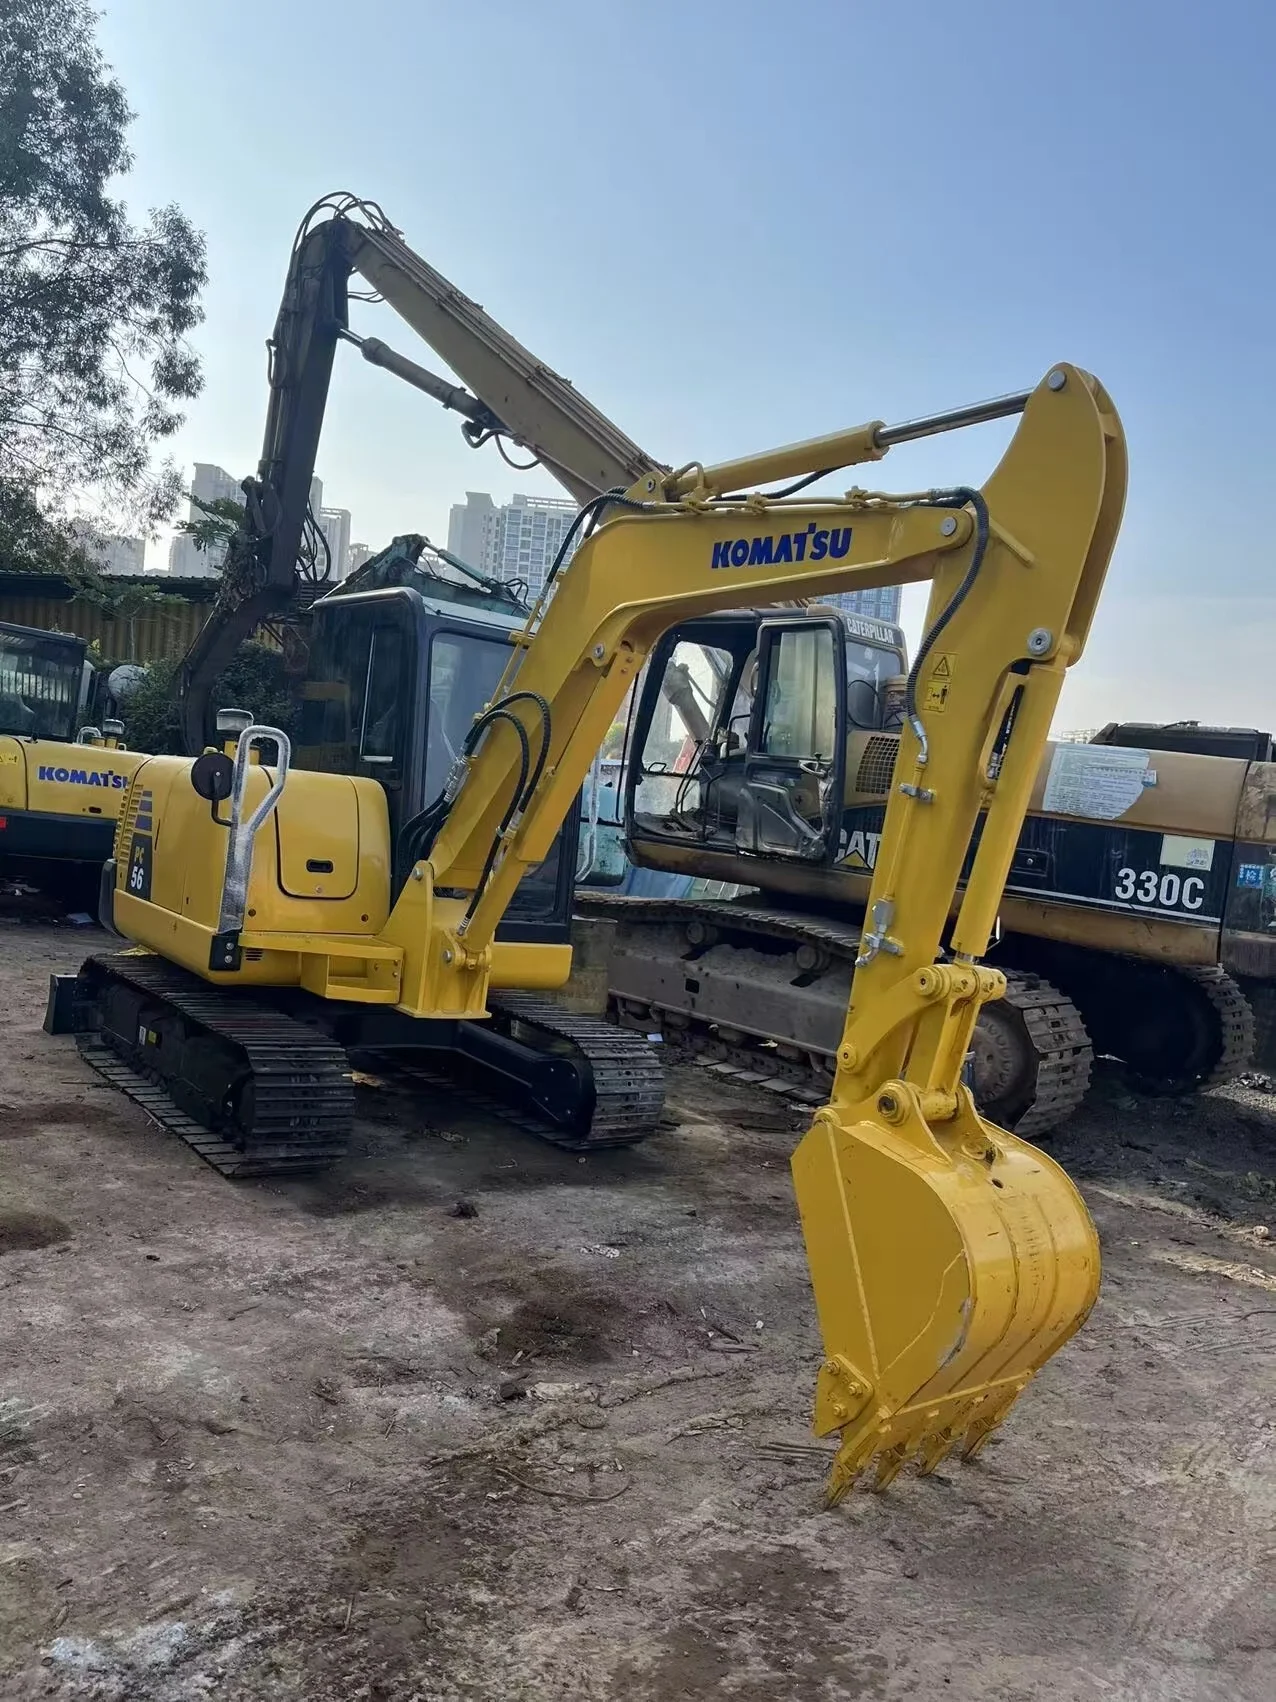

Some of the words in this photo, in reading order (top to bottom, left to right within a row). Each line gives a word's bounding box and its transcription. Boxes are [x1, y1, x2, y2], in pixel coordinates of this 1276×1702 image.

[711, 522, 853, 569] KOMATSU
[846, 617, 895, 645] CATERPILLAR
[134, 845, 145, 865] PC
[130, 865, 144, 890] 56
[1115, 867, 1204, 910] 330C
